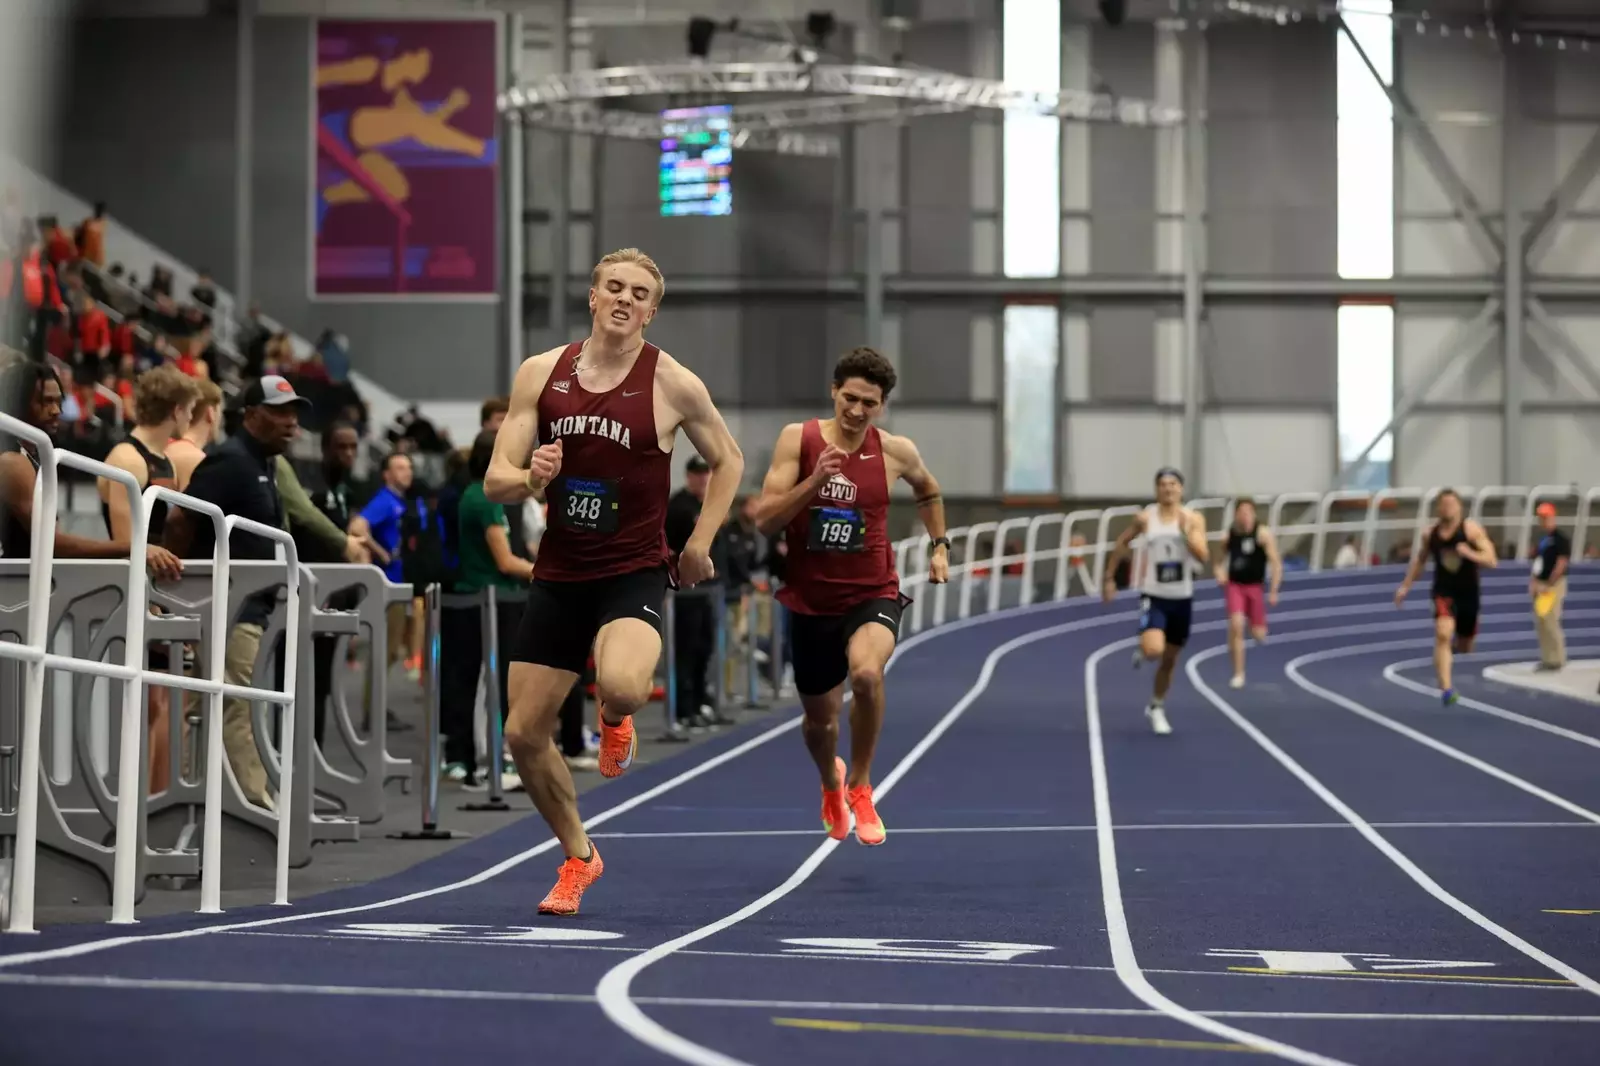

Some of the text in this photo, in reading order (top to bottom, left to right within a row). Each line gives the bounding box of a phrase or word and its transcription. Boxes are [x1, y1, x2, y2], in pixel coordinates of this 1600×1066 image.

[550, 415, 631, 449] MONTANA
[820, 482, 855, 500] CWU
[567, 495, 601, 519] 348
[821, 522, 853, 543] 199
